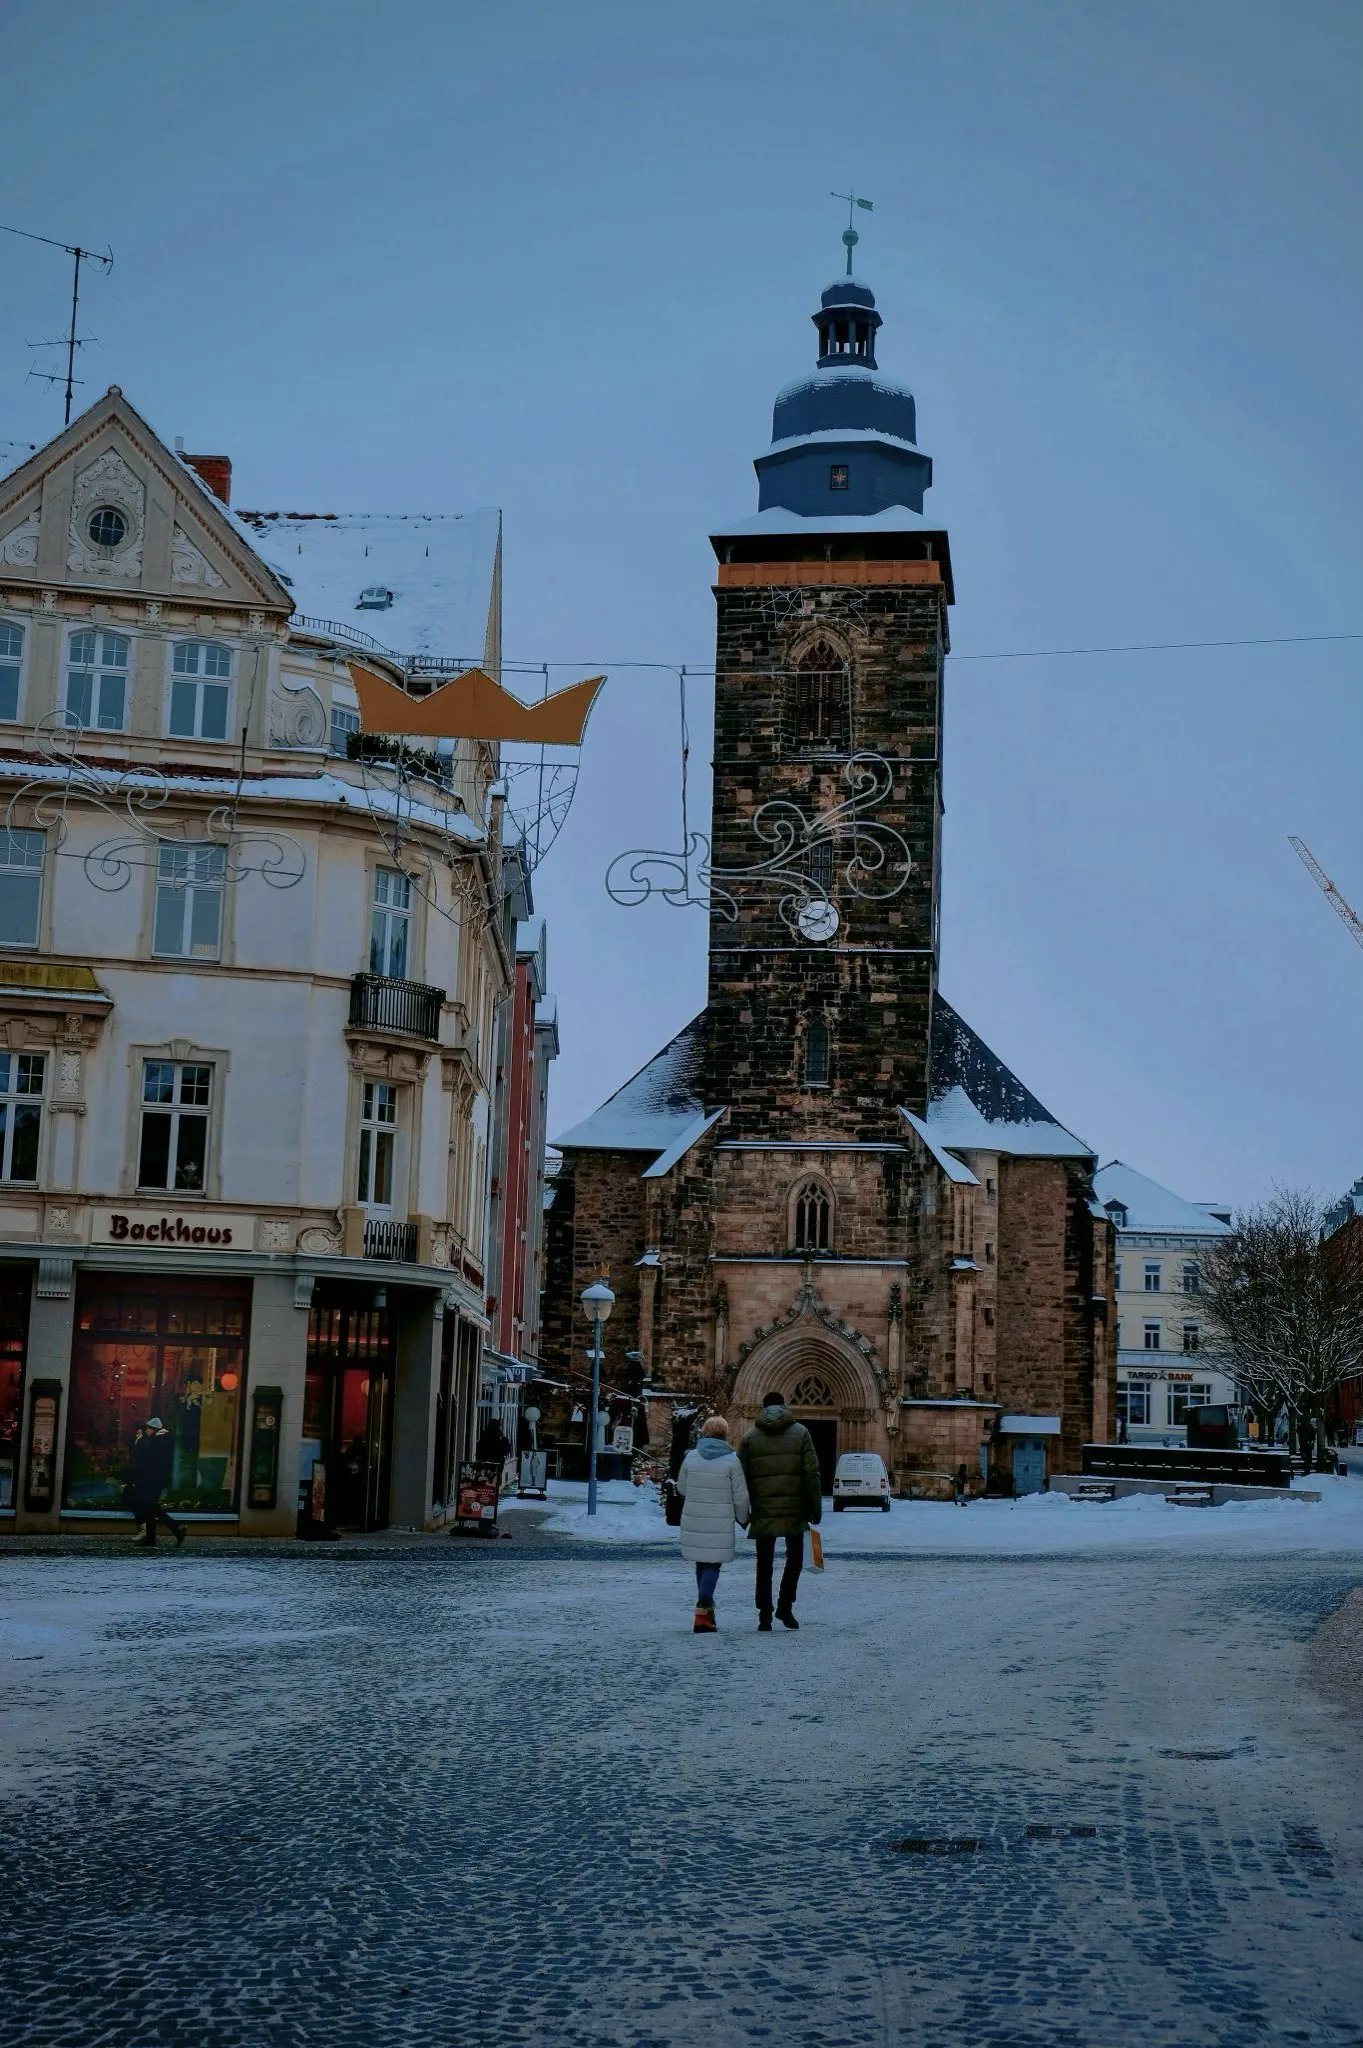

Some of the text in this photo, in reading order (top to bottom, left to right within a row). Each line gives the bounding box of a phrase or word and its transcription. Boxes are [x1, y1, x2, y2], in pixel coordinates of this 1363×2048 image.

[109, 1214, 233, 1244] Backhaus
[1127, 1371, 1194, 1381] TARGO BANK
